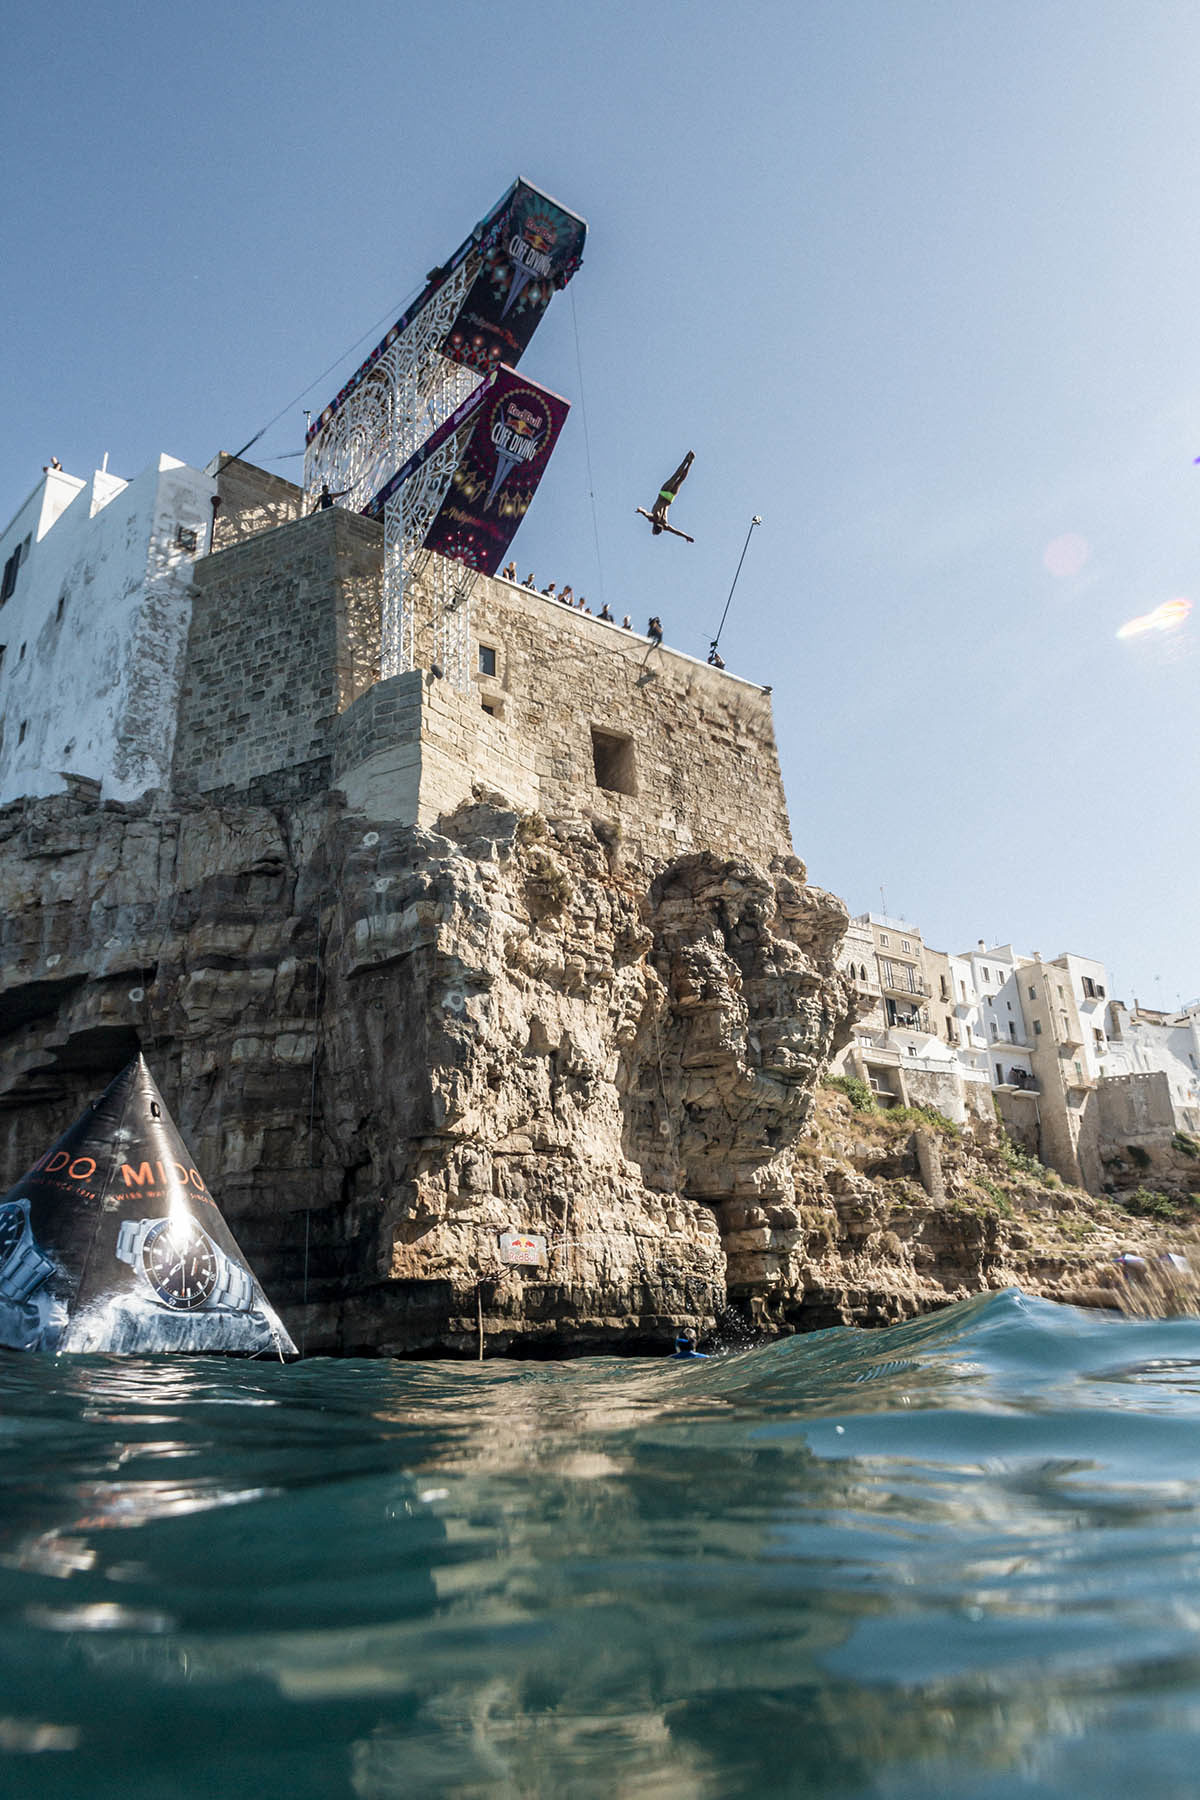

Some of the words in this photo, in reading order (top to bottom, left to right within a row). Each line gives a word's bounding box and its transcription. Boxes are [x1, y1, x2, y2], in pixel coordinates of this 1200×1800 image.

[509, 234, 530, 263] CLIFF
[525, 247, 553, 277] DIVING
[490, 421, 513, 449] CLIFF
[509, 435, 538, 462] DIVING
